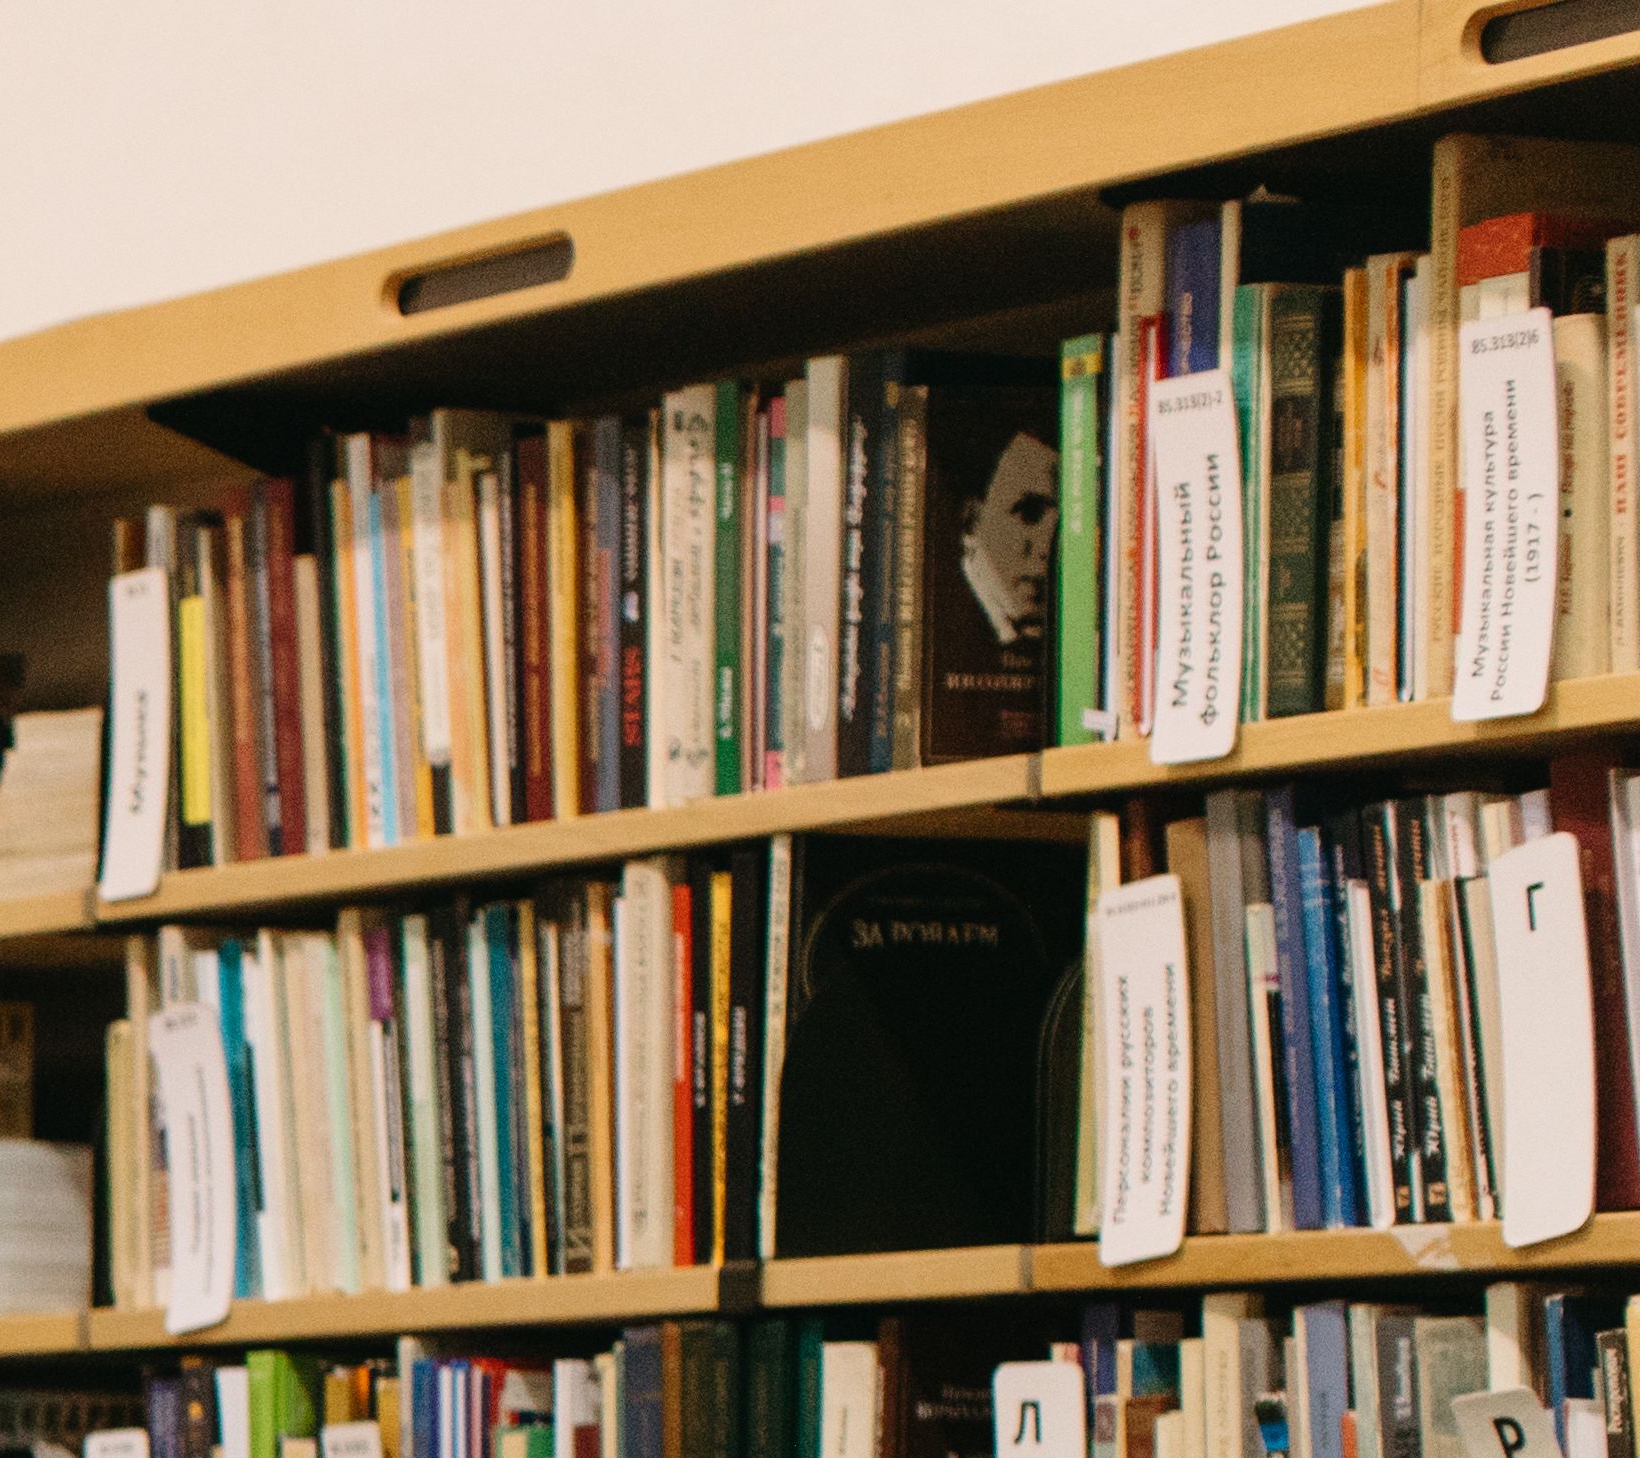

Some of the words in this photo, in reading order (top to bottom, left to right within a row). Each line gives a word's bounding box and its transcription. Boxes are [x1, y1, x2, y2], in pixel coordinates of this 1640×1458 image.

[1202, 455, 1224, 561] России
[1481, 411, 1501, 513] культура
[1489, 625, 1511, 702] России
[1505, 380, 1522, 481] времени
[1169, 482, 1198, 708] Музыкальный
[1470, 521, 1496, 678] Музыкальная
[1525, 879, 1545, 932] Г
[1115, 976, 1135, 1070] русских
[1163, 964, 1180, 1074] времени
[1013, 1399, 1043, 1446] Л
